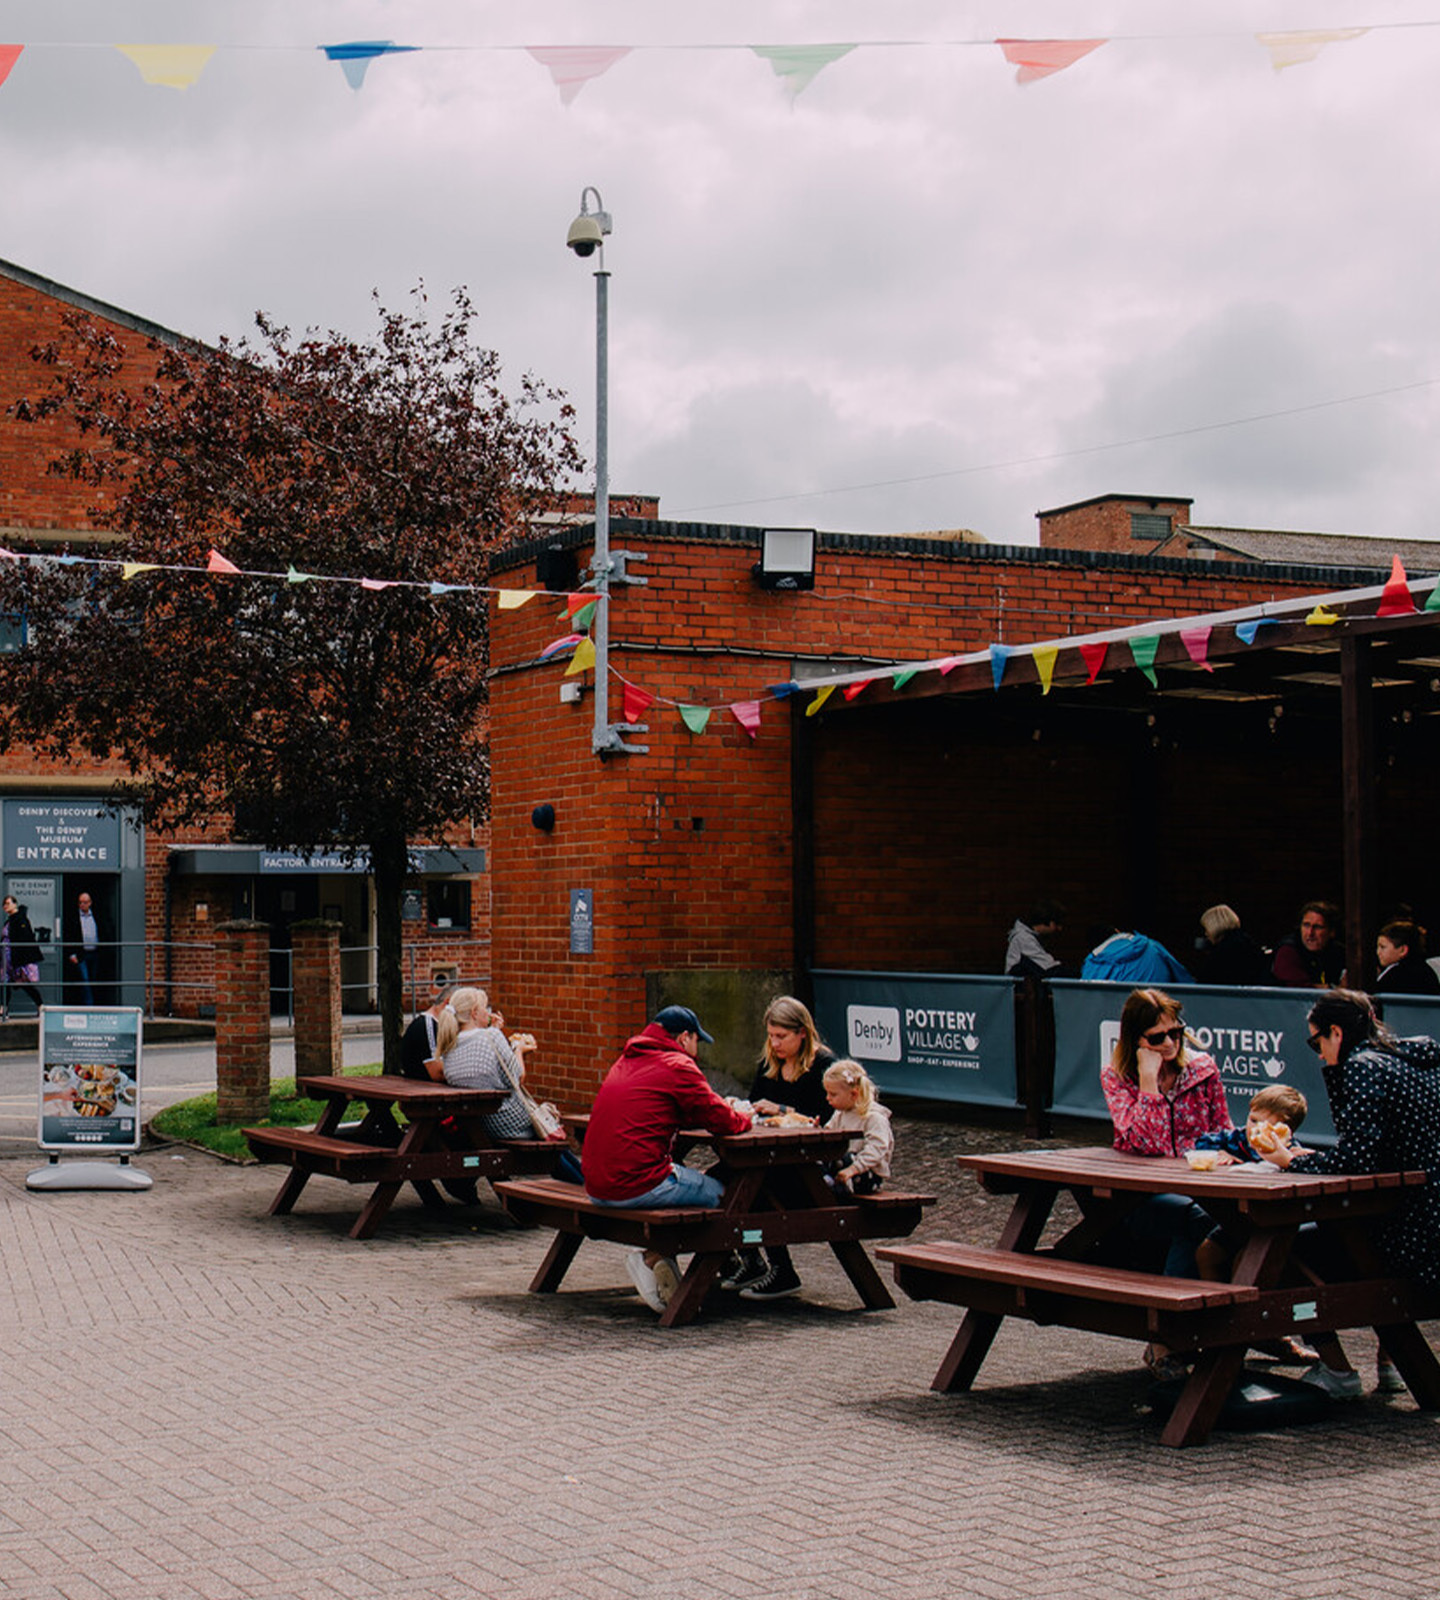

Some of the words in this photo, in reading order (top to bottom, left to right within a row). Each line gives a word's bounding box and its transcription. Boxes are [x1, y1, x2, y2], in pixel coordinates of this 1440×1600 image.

[18, 807, 51, 816] DENBY
[35, 826, 55, 834] THE
[57, 826, 88, 834] DENBY
[16, 847, 107, 859] ENTRANCE
[905, 1008, 976, 1031] POTTERY
[854, 1019, 894, 1046] Denby
[907, 1031, 961, 1051] VILLAGE
